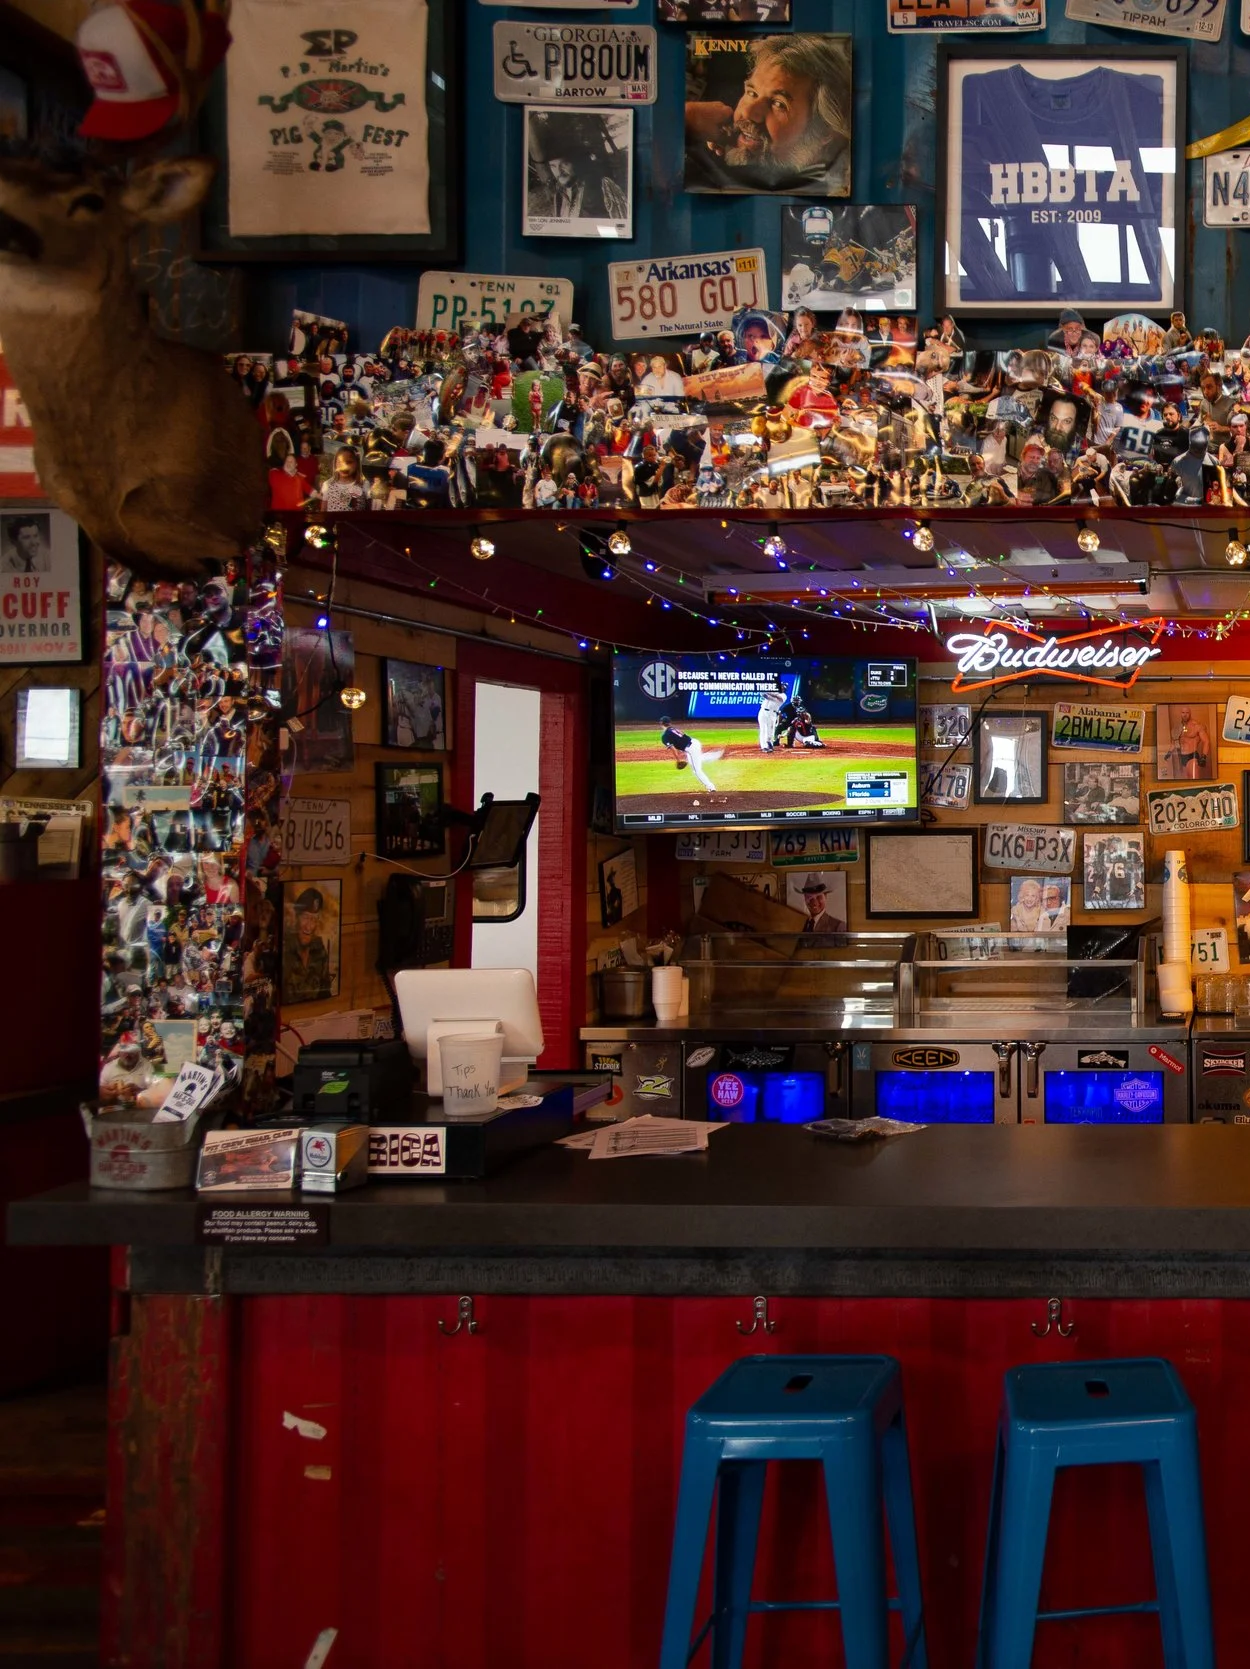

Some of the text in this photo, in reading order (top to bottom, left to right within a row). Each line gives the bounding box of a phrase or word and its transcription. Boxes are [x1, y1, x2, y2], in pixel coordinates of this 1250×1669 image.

[1018, 11, 1036, 20] MAY
[1122, 11, 1166, 27] TIPPAH
[931, 19, 1002, 28] TRAVEL2SC.COM
[694, 38, 750, 57] KENNY
[555, 87, 608, 97] BARTOW
[631, 85, 648, 93] MAR
[270, 126, 304, 146] PIG
[362, 125, 410, 147] FEST
[989, 159, 1141, 205] HBBTA
[1031, 210, 1102, 224] EST: 2009
[645, 259, 731, 283] Arkansas
[478, 281, 516, 292] TENN
[546, 285, 561, 295] 81
[616, 281, 678, 323] 580
[660, 319, 724, 332] The Natural State
[13, 577, 40, 588] ROY
[3, 591, 70, 620] CUFF
[945, 633, 1162, 673] Budweiser
[641, 662, 676, 698] SEC
[678, 671, 765, 680] BECAUSE NEVER CALLED
[678, 682, 779, 691] GOOD COMMUNICATION THERE.
[1078, 706, 1121, 718] Alabama
[936, 715, 968, 738] 320
[1060, 715, 1139, 742] 2BM1577
[299, 802, 324, 811] TENN
[1154, 802, 1188, 825] 202
[1017, 826, 1047, 834] Missouri
[1173, 820, 1217, 829] COLORADO
[989, 832, 1073, 863] CK6 P3X
[1106, 862, 1126, 879] 76
[895, 1049, 960, 1065] KEEN
[1158, 1053, 1182, 1072] Marmot
[451, 1063, 476, 1079] Tips
[181, 1070, 209, 1091] MARTIN'S
[718, 1081, 739, 1090] YEE
[446, 1084, 480, 1099] Thank
[717, 1090, 738, 1099] HAW
[1198, 1100, 1241, 1110] okuma
[221, 1130, 293, 1149] CREW CLUB
[211, 1210, 310, 1219] FOOD ALLERGY WARNING
